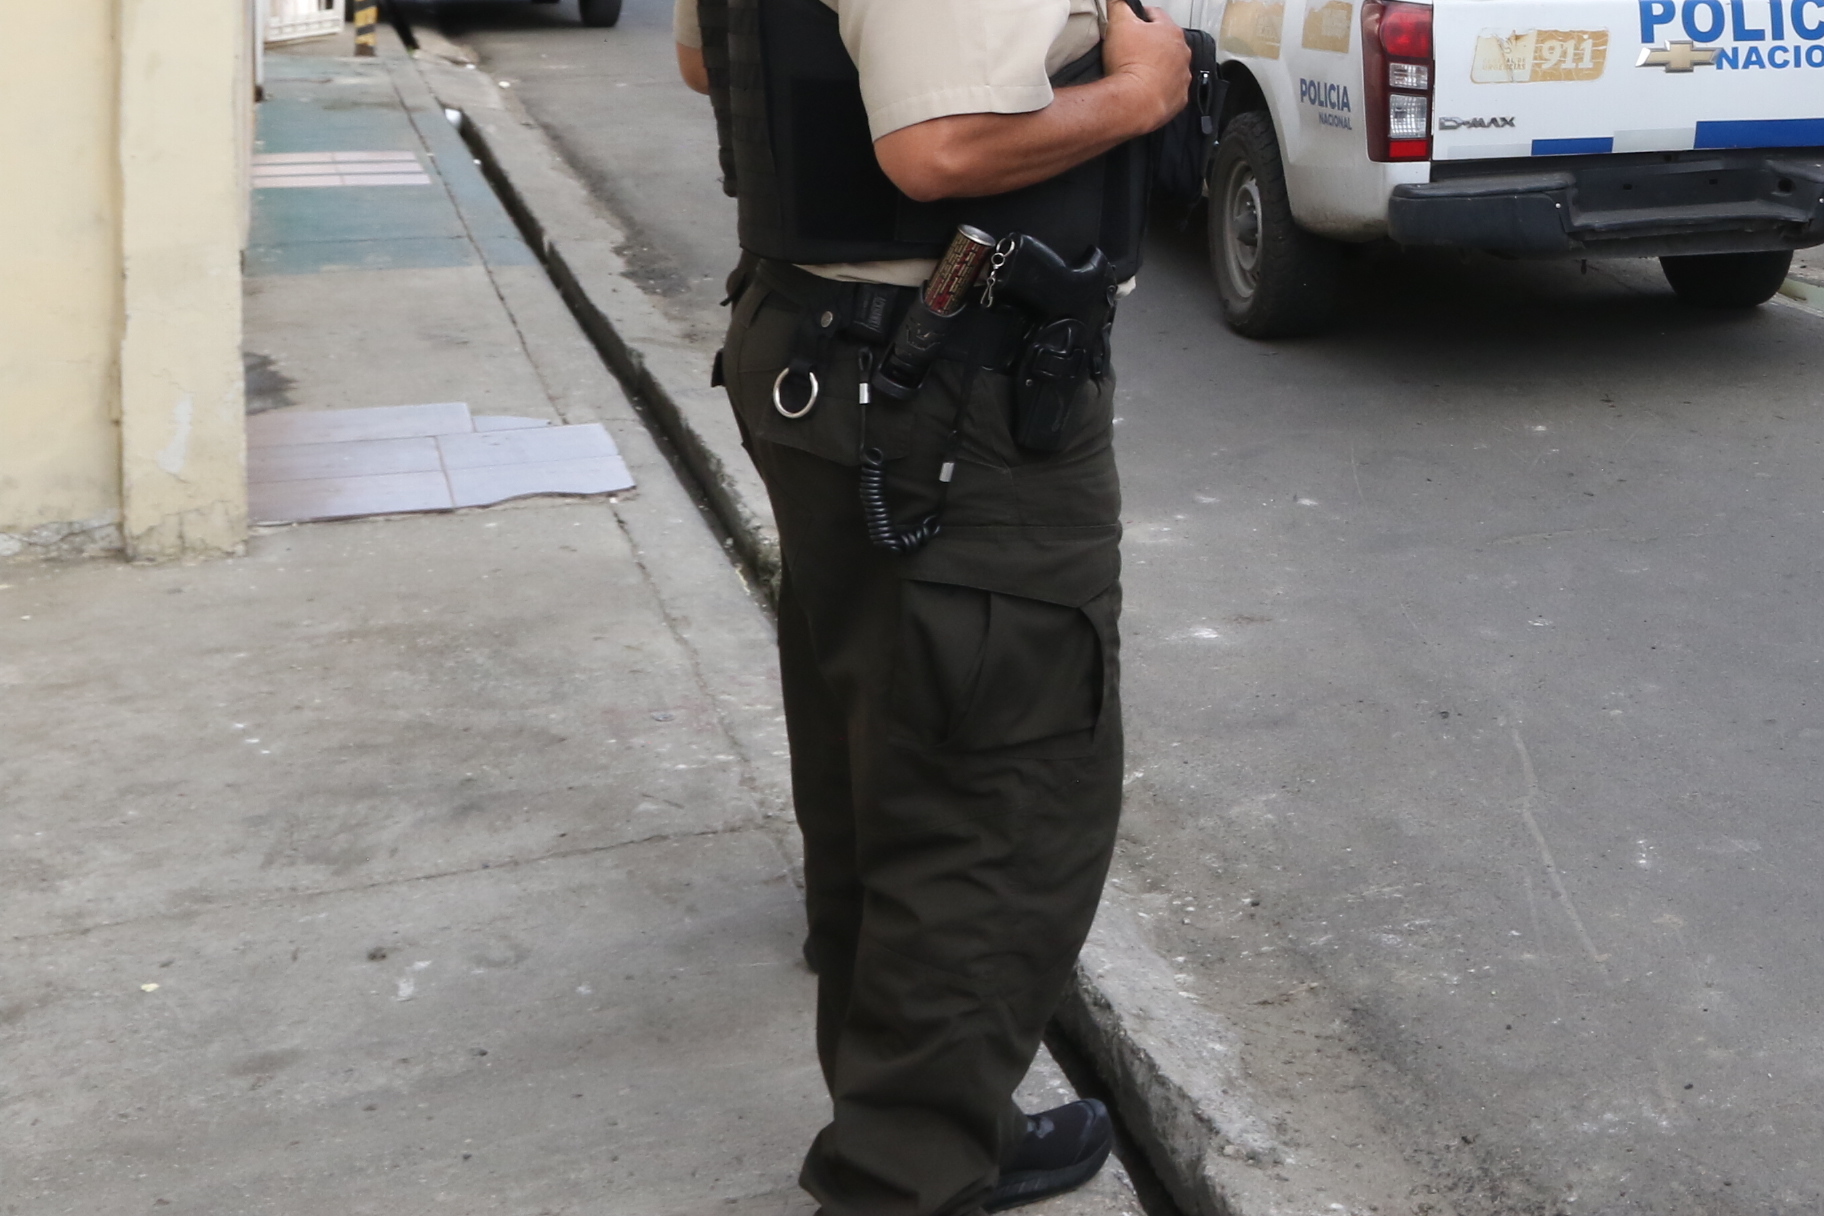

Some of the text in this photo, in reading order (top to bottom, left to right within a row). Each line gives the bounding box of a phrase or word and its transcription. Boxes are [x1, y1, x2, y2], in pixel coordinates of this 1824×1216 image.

[1541, 38, 1594, 69] 911
[1300, 77, 1351, 113] POLICIA
[1319, 112, 1352, 131] NACIONAL
[1438, 116, 1516, 131] D-MAX
